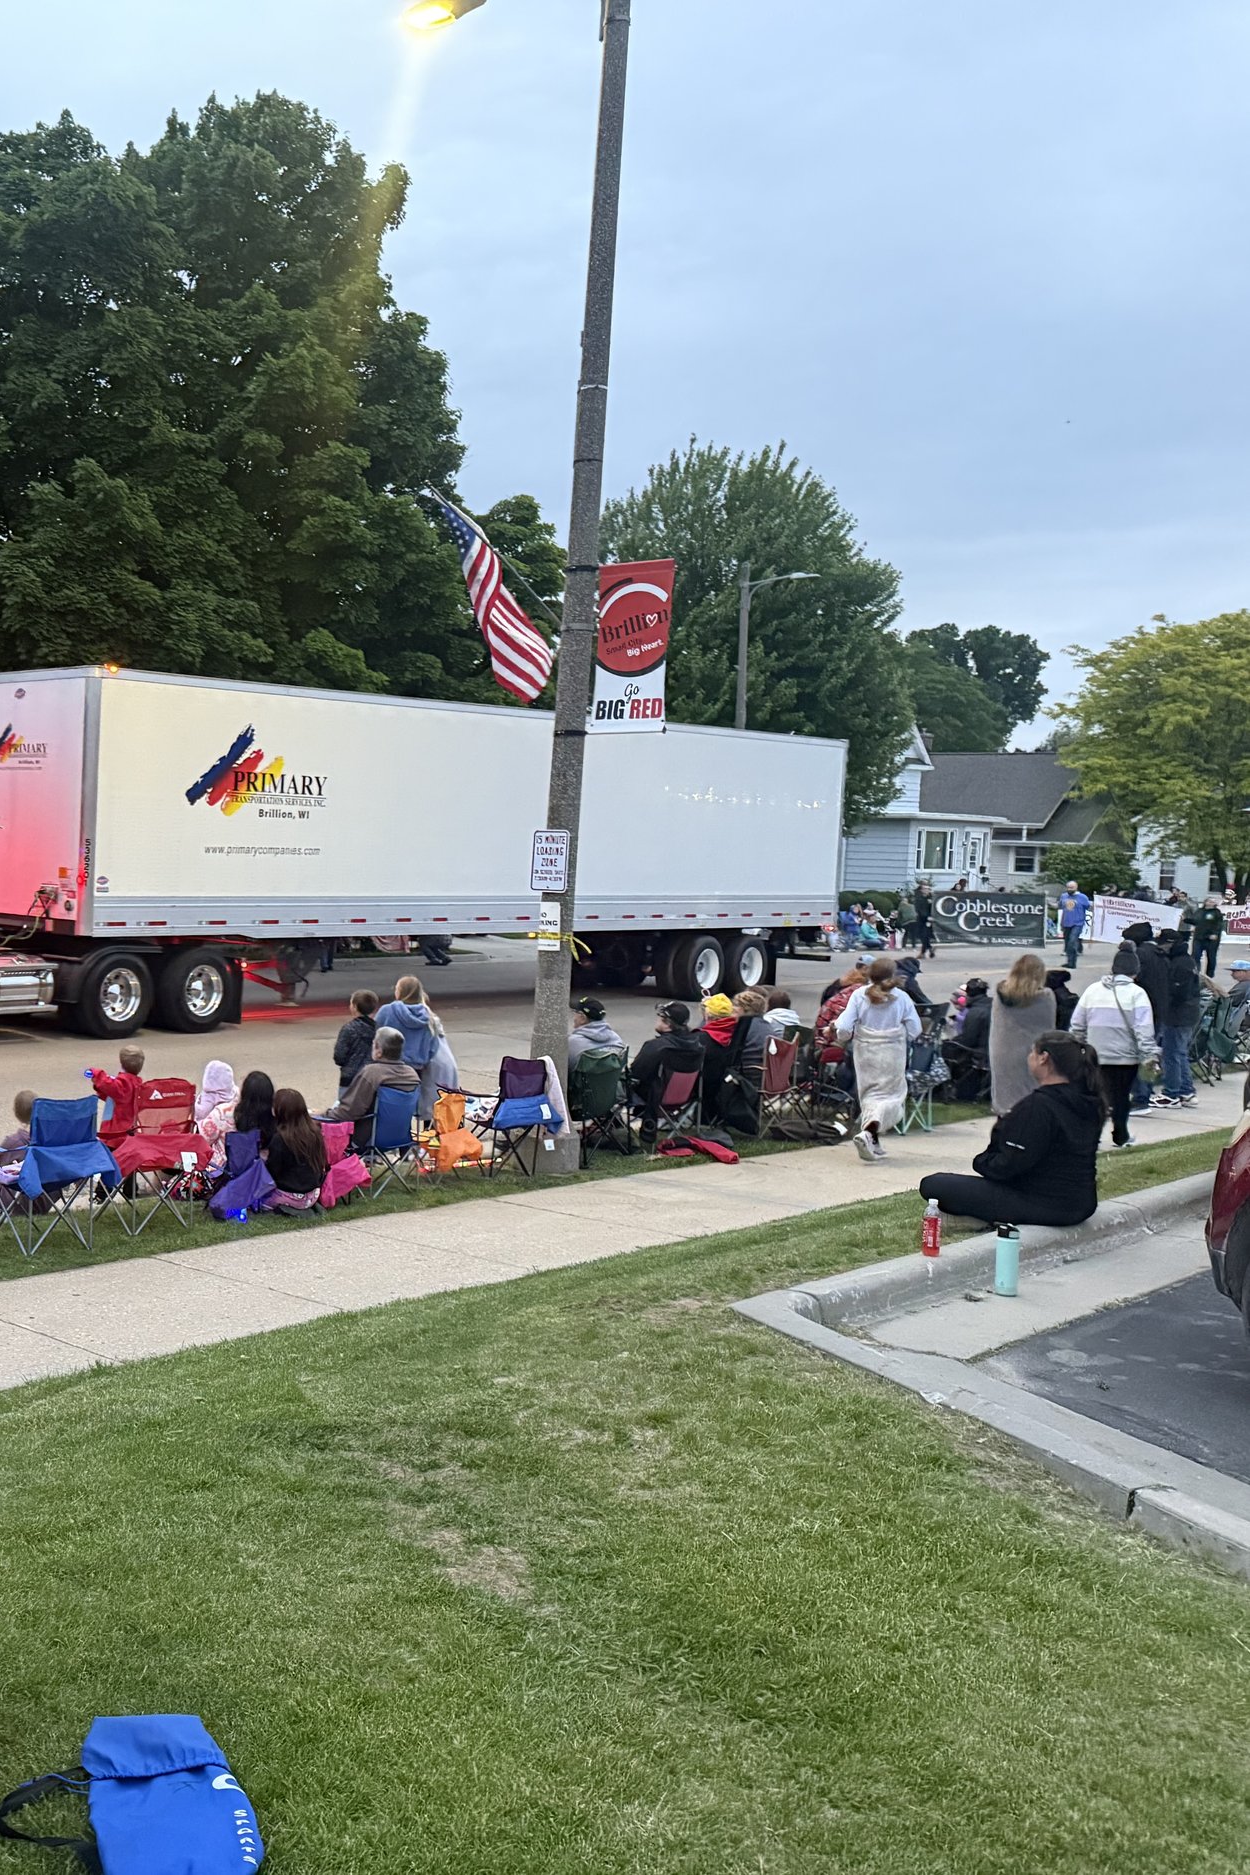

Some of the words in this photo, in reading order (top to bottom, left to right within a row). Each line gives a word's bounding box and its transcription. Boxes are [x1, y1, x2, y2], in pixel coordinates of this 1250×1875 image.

[627, 647, 640, 657] Big
[624, 683, 640, 704] Go
[595, 700, 626, 720] BIG
[629, 698, 663, 719] RED
[8, 743, 48, 754] PRIMARY
[233, 770, 328, 797] PRIMARY
[231, 794, 284, 806] TRANSPORTATION
[258, 808, 296, 820] Brillion,
[298, 810, 310, 820] WI
[204, 846, 321, 857] www.primarycompanies.com
[536, 846, 565, 856] LOADING
[541, 857, 558, 867] ZONE
[936, 895, 1044, 917] Cobblestone
[958, 910, 1015, 931] Creek
